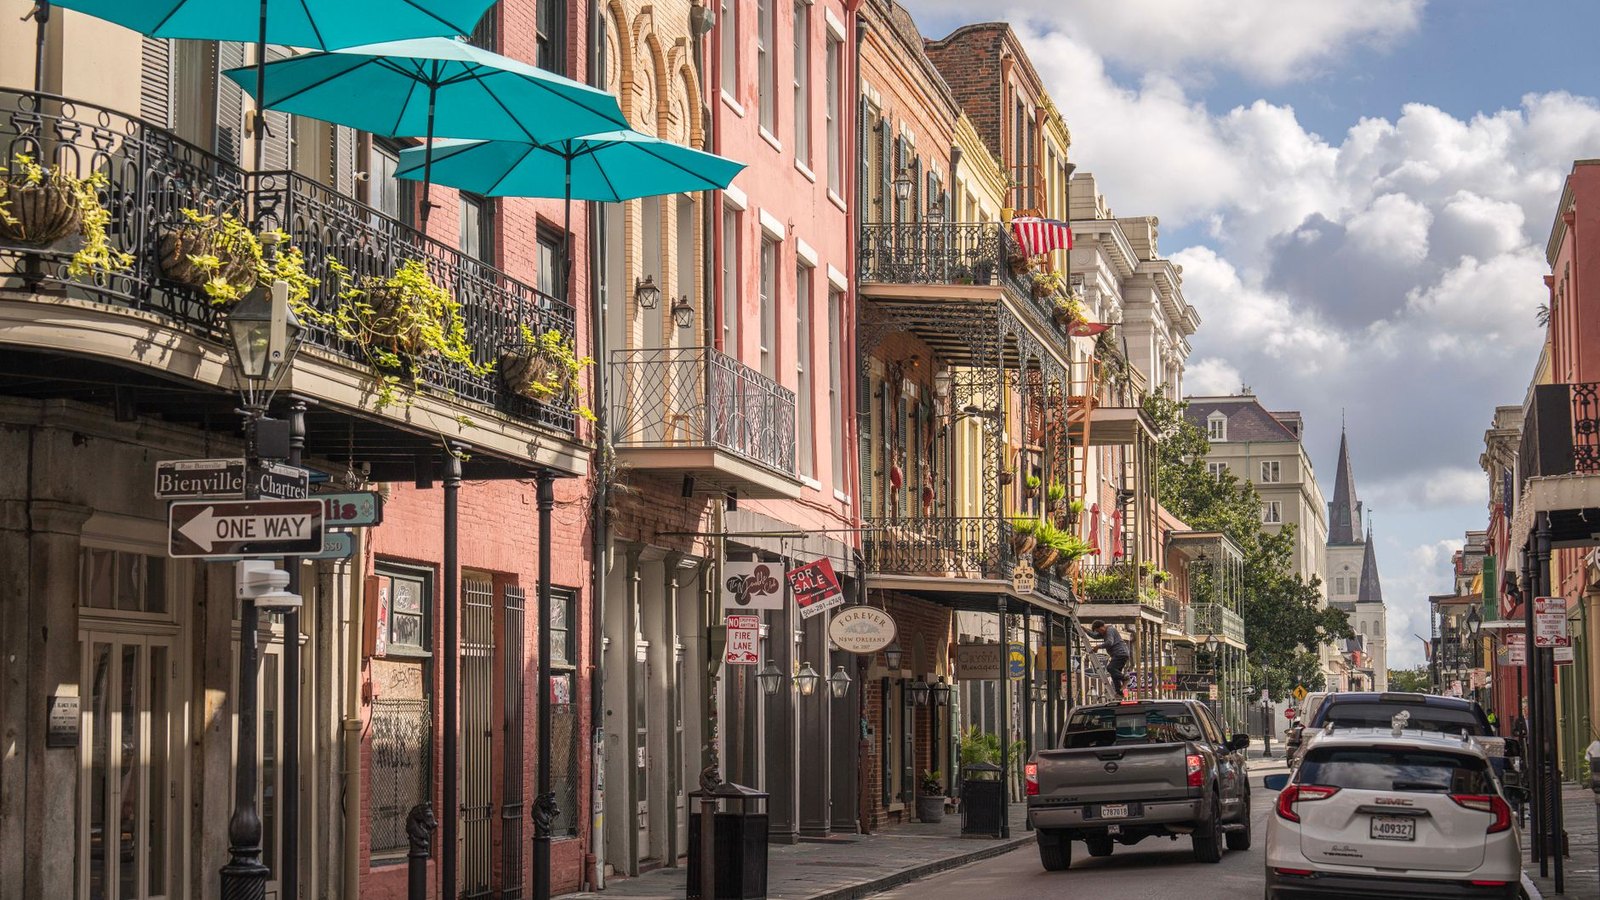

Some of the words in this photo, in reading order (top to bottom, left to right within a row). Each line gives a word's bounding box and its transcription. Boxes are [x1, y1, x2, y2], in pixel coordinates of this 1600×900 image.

[160, 472, 242, 492] Bienville
[260, 474, 306, 499] Chartres
[216, 518, 256, 539] ONE
[264, 517, 306, 538] WAY
[790, 568, 814, 584] FOR
[793, 574, 826, 594] SALE
[729, 618, 739, 628] NO
[838, 612, 886, 627] FOREVER
[735, 632, 751, 640] FIRE
[734, 642, 752, 650] LANE
[1375, 798, 1413, 806] GMC
[1379, 823, 1412, 835] 409327
